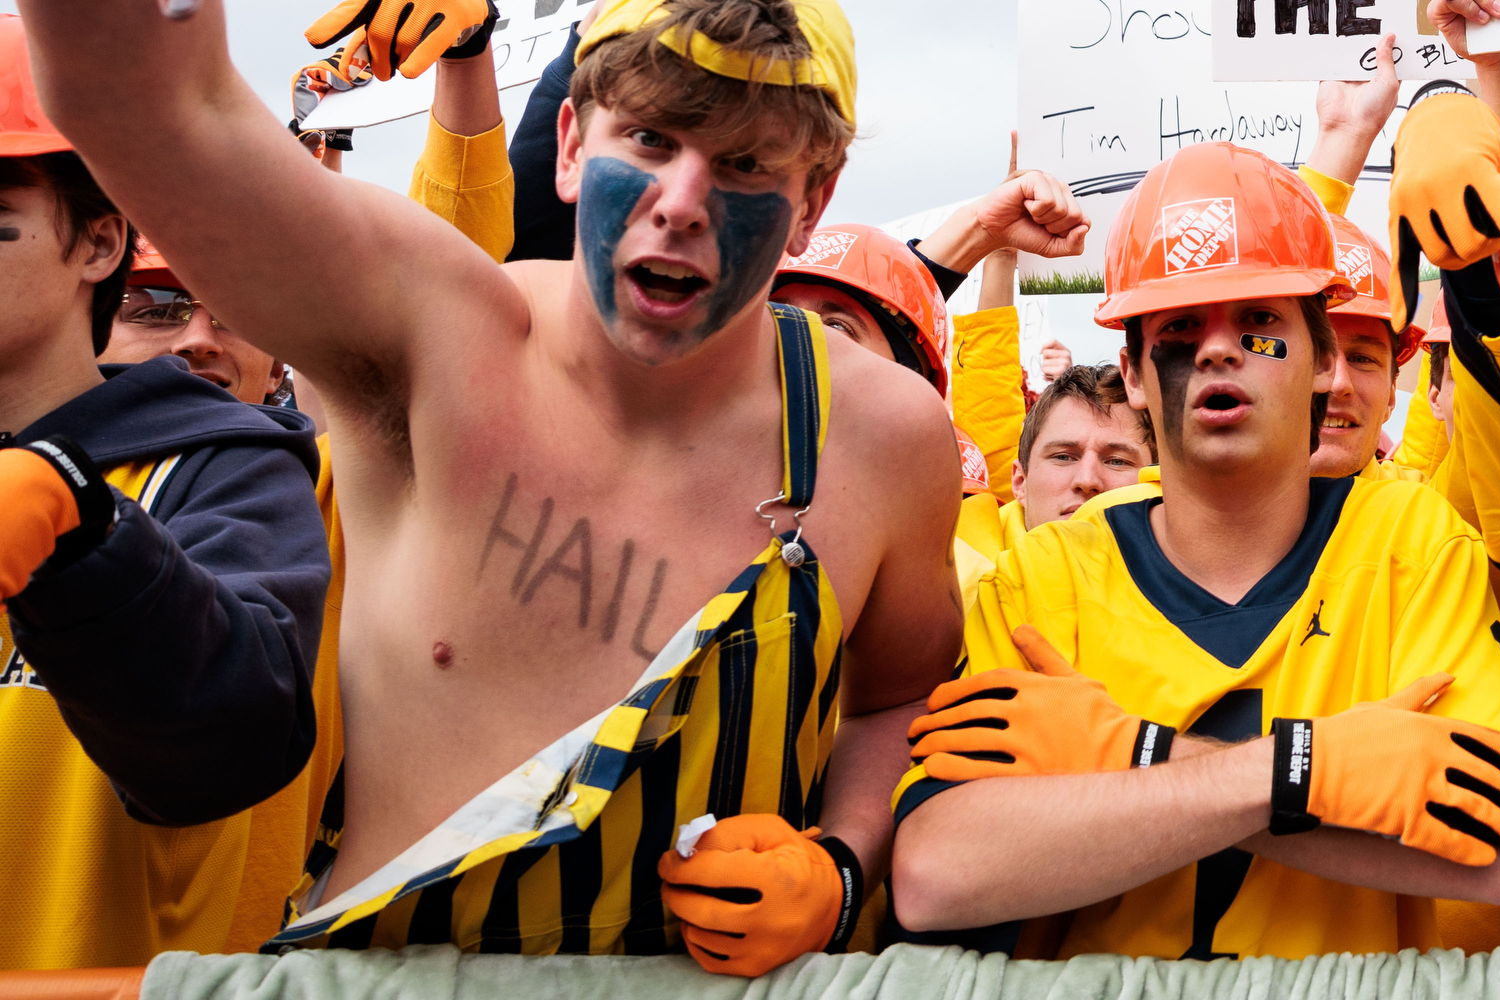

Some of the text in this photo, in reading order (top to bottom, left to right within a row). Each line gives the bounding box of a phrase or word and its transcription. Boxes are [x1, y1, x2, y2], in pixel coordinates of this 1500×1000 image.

[1042, 106, 1127, 160] Tim
[809, 233, 828, 245] HE
[1166, 199, 1234, 271] HOME
[1170, 208, 1200, 236] THE
[806, 244, 847, 266] DEPOT
[1192, 220, 1235, 267] DEPOT
[1252, 337, 1276, 356] M
[476, 472, 669, 662] HAIL
[842, 867, 853, 908] GAMEDAY
